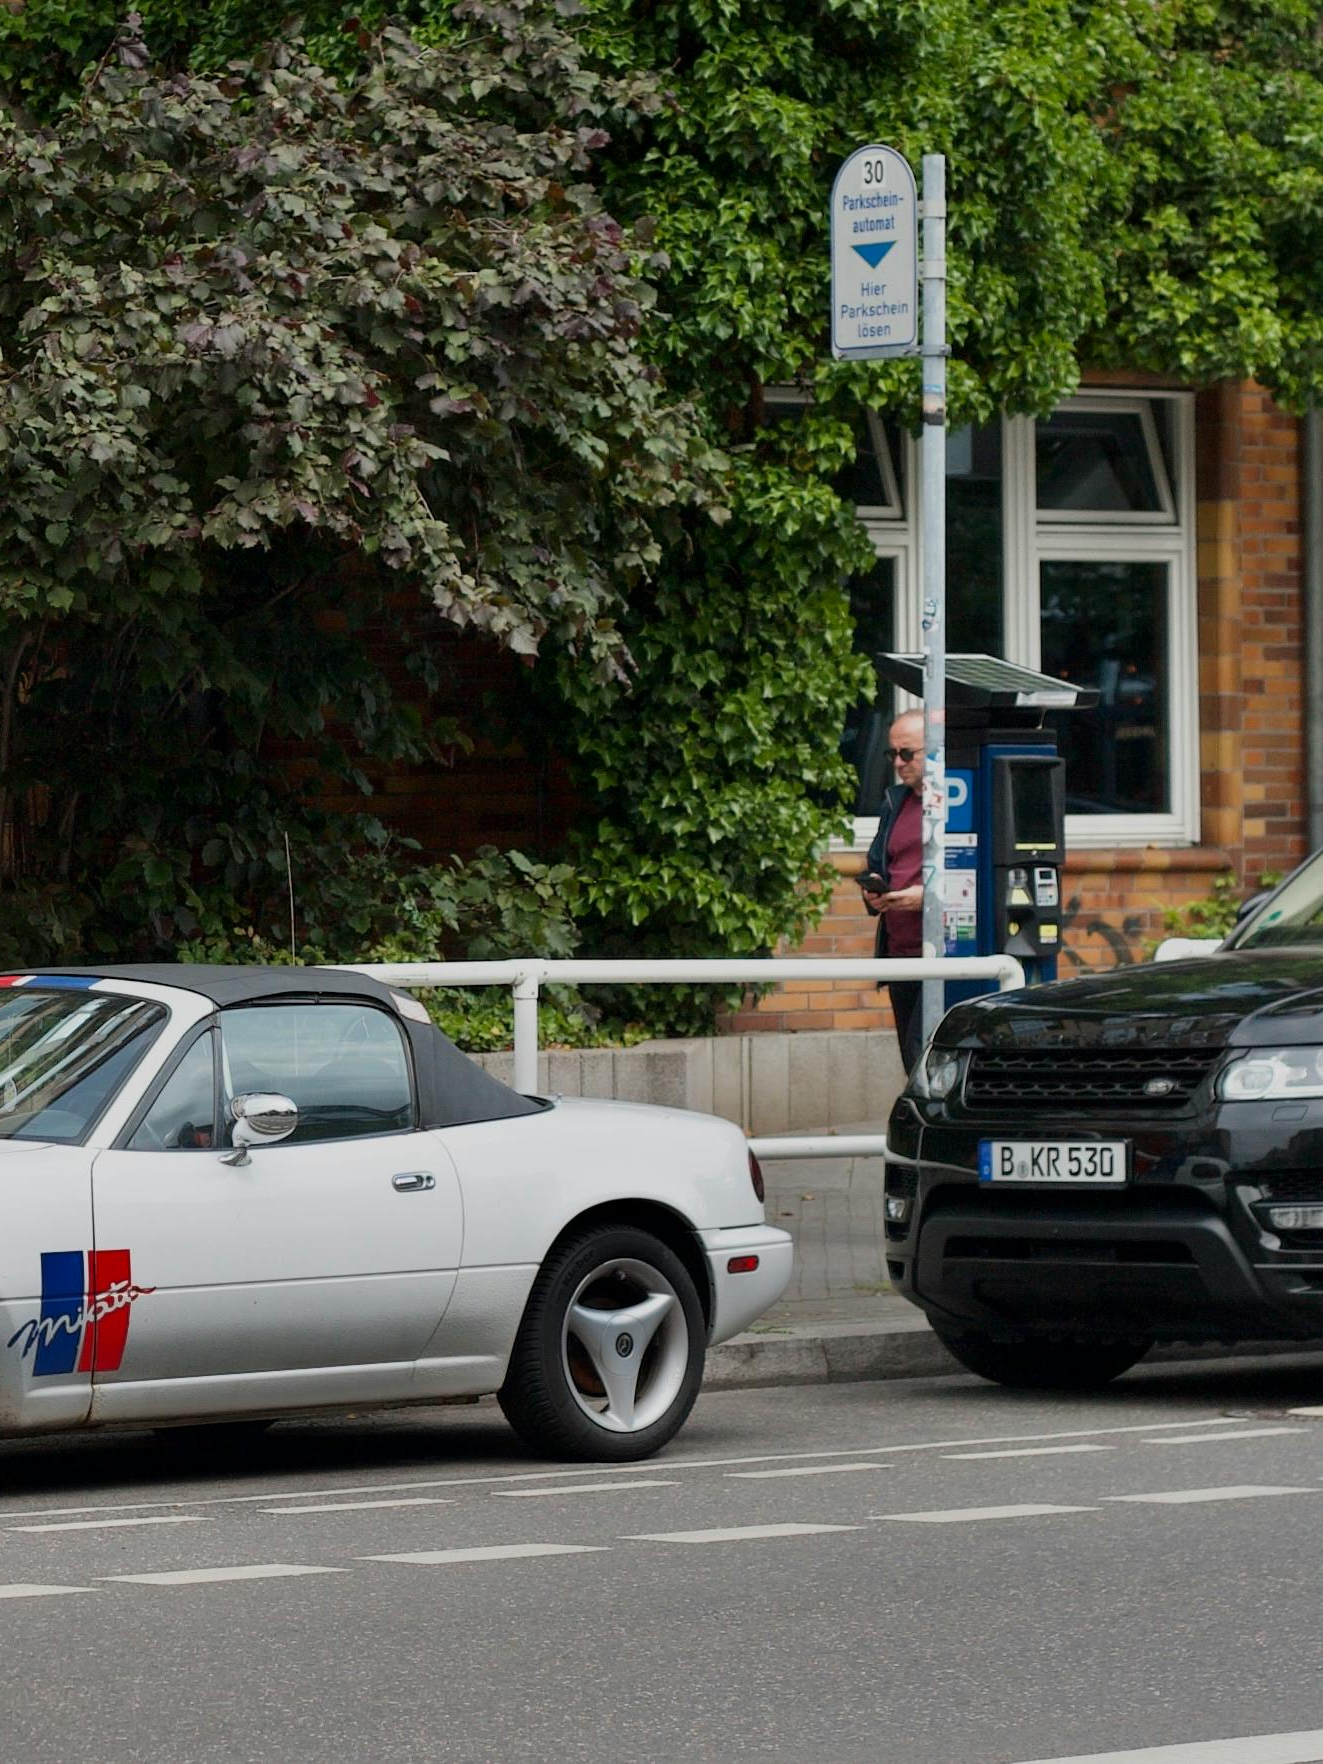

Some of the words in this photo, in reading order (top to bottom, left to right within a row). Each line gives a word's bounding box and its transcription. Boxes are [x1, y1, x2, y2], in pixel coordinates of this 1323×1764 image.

[864, 160, 884, 184] 30
[843, 191, 904, 211] Parkschein-
[853, 214, 895, 233] automat
[861, 281, 887, 296] Hier
[841, 301, 908, 319] Parkschein
[858, 323, 891, 338] lösen
[944, 777, 968, 822] P
[1001, 1147, 1014, 1176] B
[1031, 1147, 1061, 1177] KR
[1068, 1147, 1114, 1177] 530
